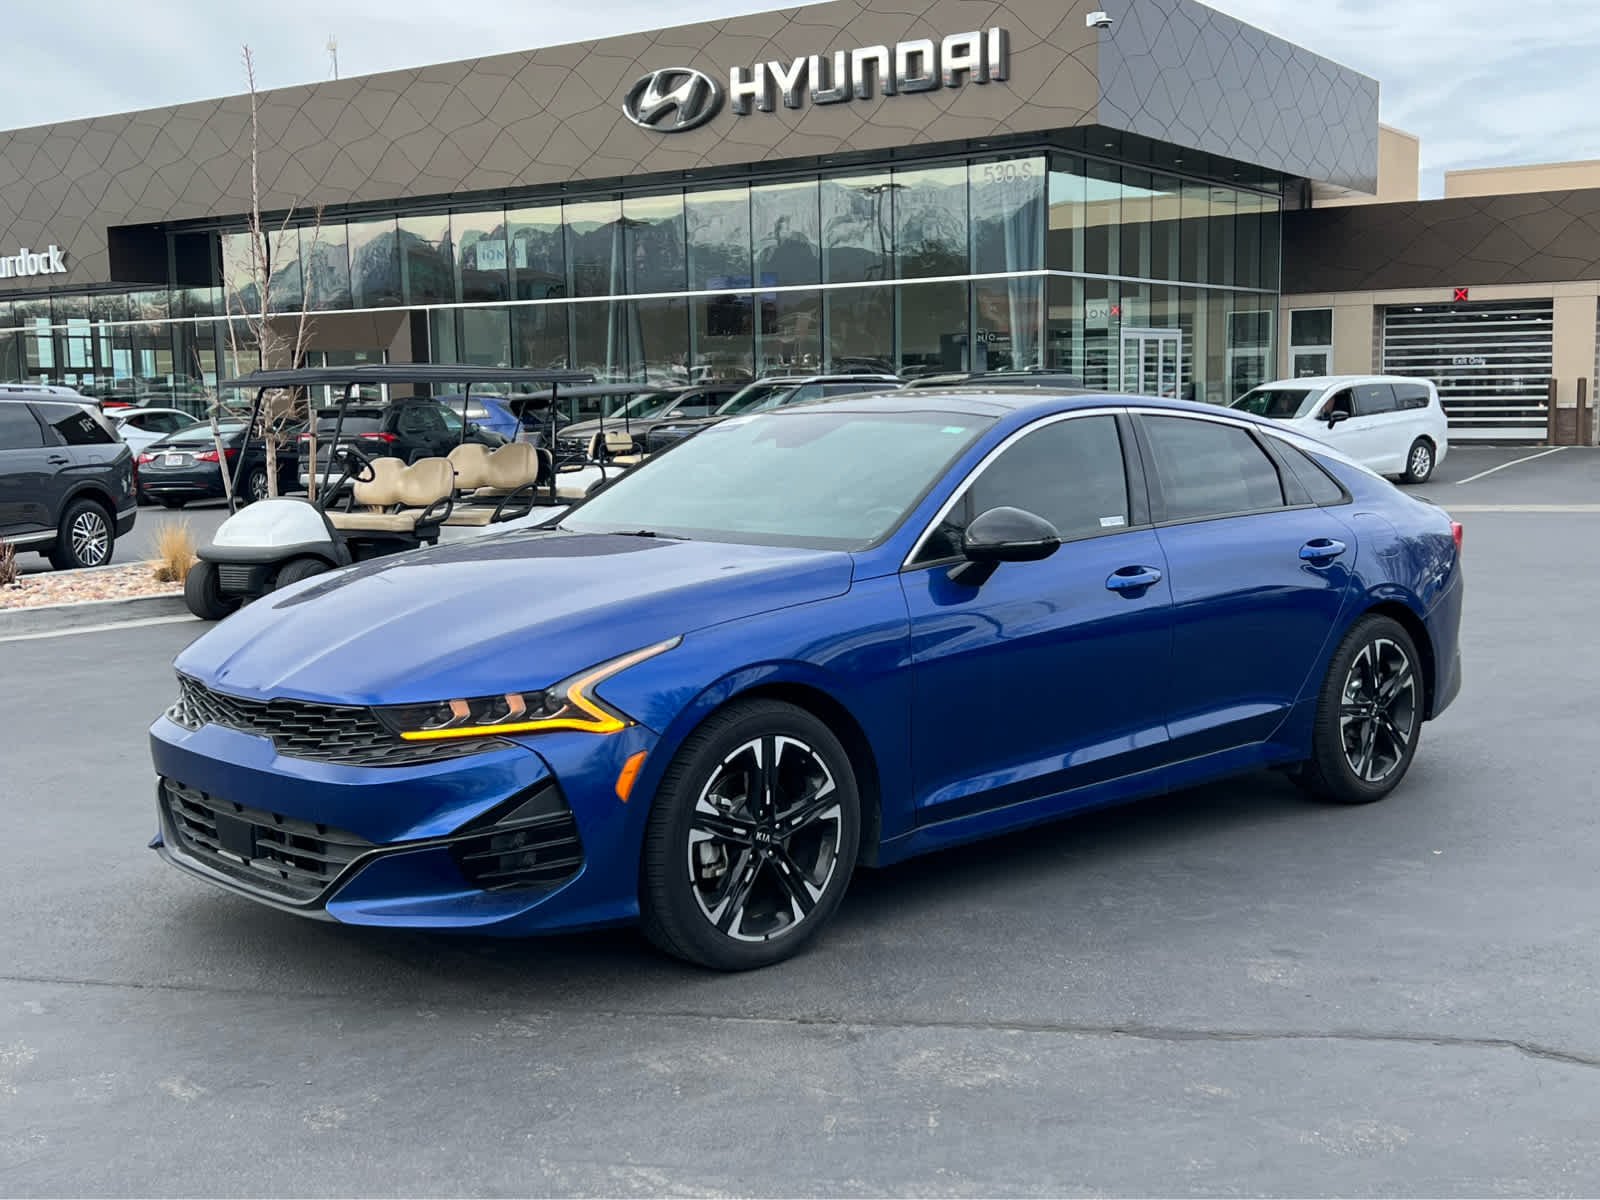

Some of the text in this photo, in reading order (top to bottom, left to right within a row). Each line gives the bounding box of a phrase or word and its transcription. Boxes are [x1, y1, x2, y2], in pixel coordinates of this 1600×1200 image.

[730, 27, 1008, 115] HYUNDAI
[984, 161, 1032, 184] 530 S
[756, 832, 770, 843] KIA
